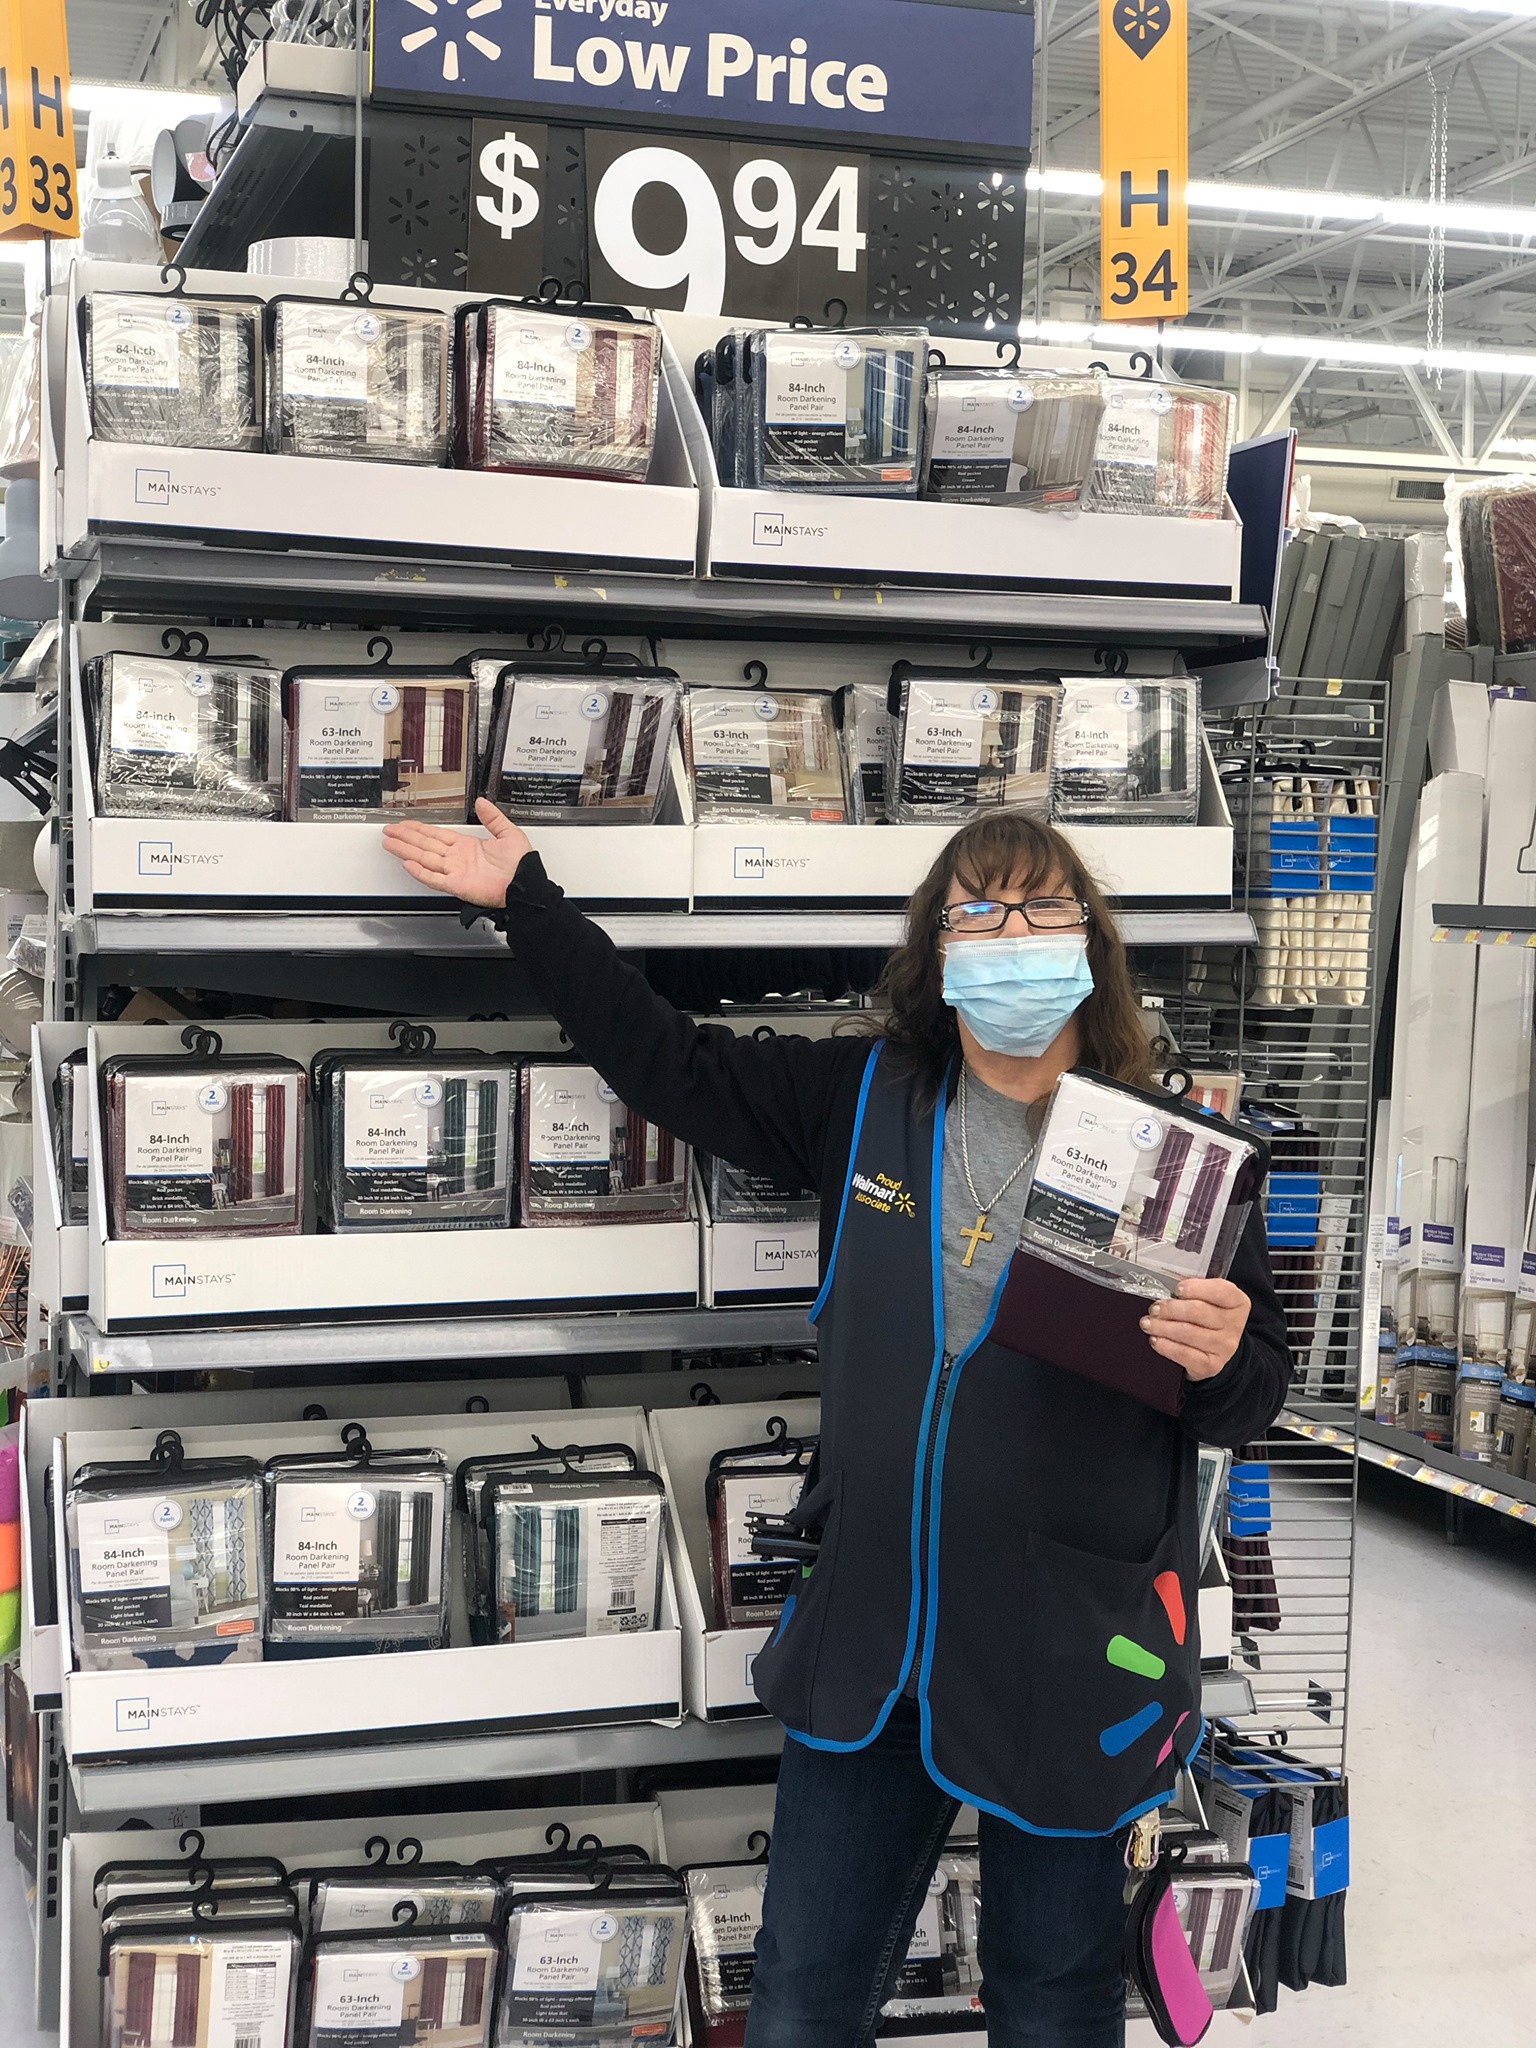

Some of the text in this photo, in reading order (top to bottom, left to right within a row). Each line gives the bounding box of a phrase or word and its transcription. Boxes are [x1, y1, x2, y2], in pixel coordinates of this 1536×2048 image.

[533, 15, 888, 113] Low Price
[31, 66, 64, 137] H
[30, 156, 73, 220] 33
[1121, 170, 1168, 227] H
[475, 132, 866, 315] $ 9 94
[1111, 249, 1177, 304] 34
[575, 328, 581, 337] 2
[844, 346, 849, 354] 2
[306, 354, 345, 366] 84-Inch
[517, 361, 555, 373] 84-Inch
[788, 383, 825, 393] 84-Inch
[800, 396, 836, 404] Darkening
[1108, 424, 1140, 435] 84-Inch
[381, 691, 388, 699] 2
[982, 695, 987, 703] 2
[1124, 691, 1129, 699] 2
[591, 699, 598, 707] 2
[322, 728, 361, 737] 63-Inch
[714, 730, 749, 739] 63-Inch
[927, 728, 962, 737] 63-Inch
[1075, 731, 1109, 739] 84-Inch
[334, 739, 373, 747] Darkening
[529, 737, 567, 746] 84-Inch
[937, 739, 972, 748] Darkening
[539, 748, 576, 756] Darkening
[531, 810, 561, 818] Darkening
[933, 810, 961, 818] Darkening
[425, 1085, 431, 1093] 2
[209, 1091, 215, 1099] 2
[368, 1128, 406, 1137] 84-Inch
[1142, 1124, 1151, 1134] 2
[150, 1134, 189, 1144] 84-Inch
[564, 1134, 600, 1142] Darkening
[1136, 1134, 1151, 1143] Panels
[1066, 1147, 1108, 1171] 63-Inch
[1051, 1154, 1117, 1188] Room Darkening
[876, 1173, 902, 1190] Proud
[1061, 1170, 1101, 1190] Panel Pair
[852, 1173, 895, 1202] Walmart
[855, 1192, 891, 1213] Associate
[1067, 1210, 1084, 1221] pocket
[1050, 1213, 1086, 1232] Deep burgundy
[1033, 1231, 1090, 1260] Room Darkening
[765, 1250, 819, 1260] MAINSTAY
[358, 1498, 364, 1506] 2
[164, 1507, 170, 1516] 2
[298, 1542, 337, 1551] 84-Inch
[103, 1548, 145, 1560] 84-Inch
[117, 1559, 157, 1570] Darkening
[106, 1570, 128, 1578] Panel
[122, 1635, 156, 1643] Darkening
[715, 1913, 750, 1924] 84-Inch
[718, 1934, 737, 1942] Panel
[540, 1957, 578, 1965] 63-Inch
[551, 1966, 588, 1974] Darkening
[340, 1995, 379, 2003] 63-Inch
[352, 2004, 391, 2012] Darkening
[543, 2031, 575, 2039] Darkening
